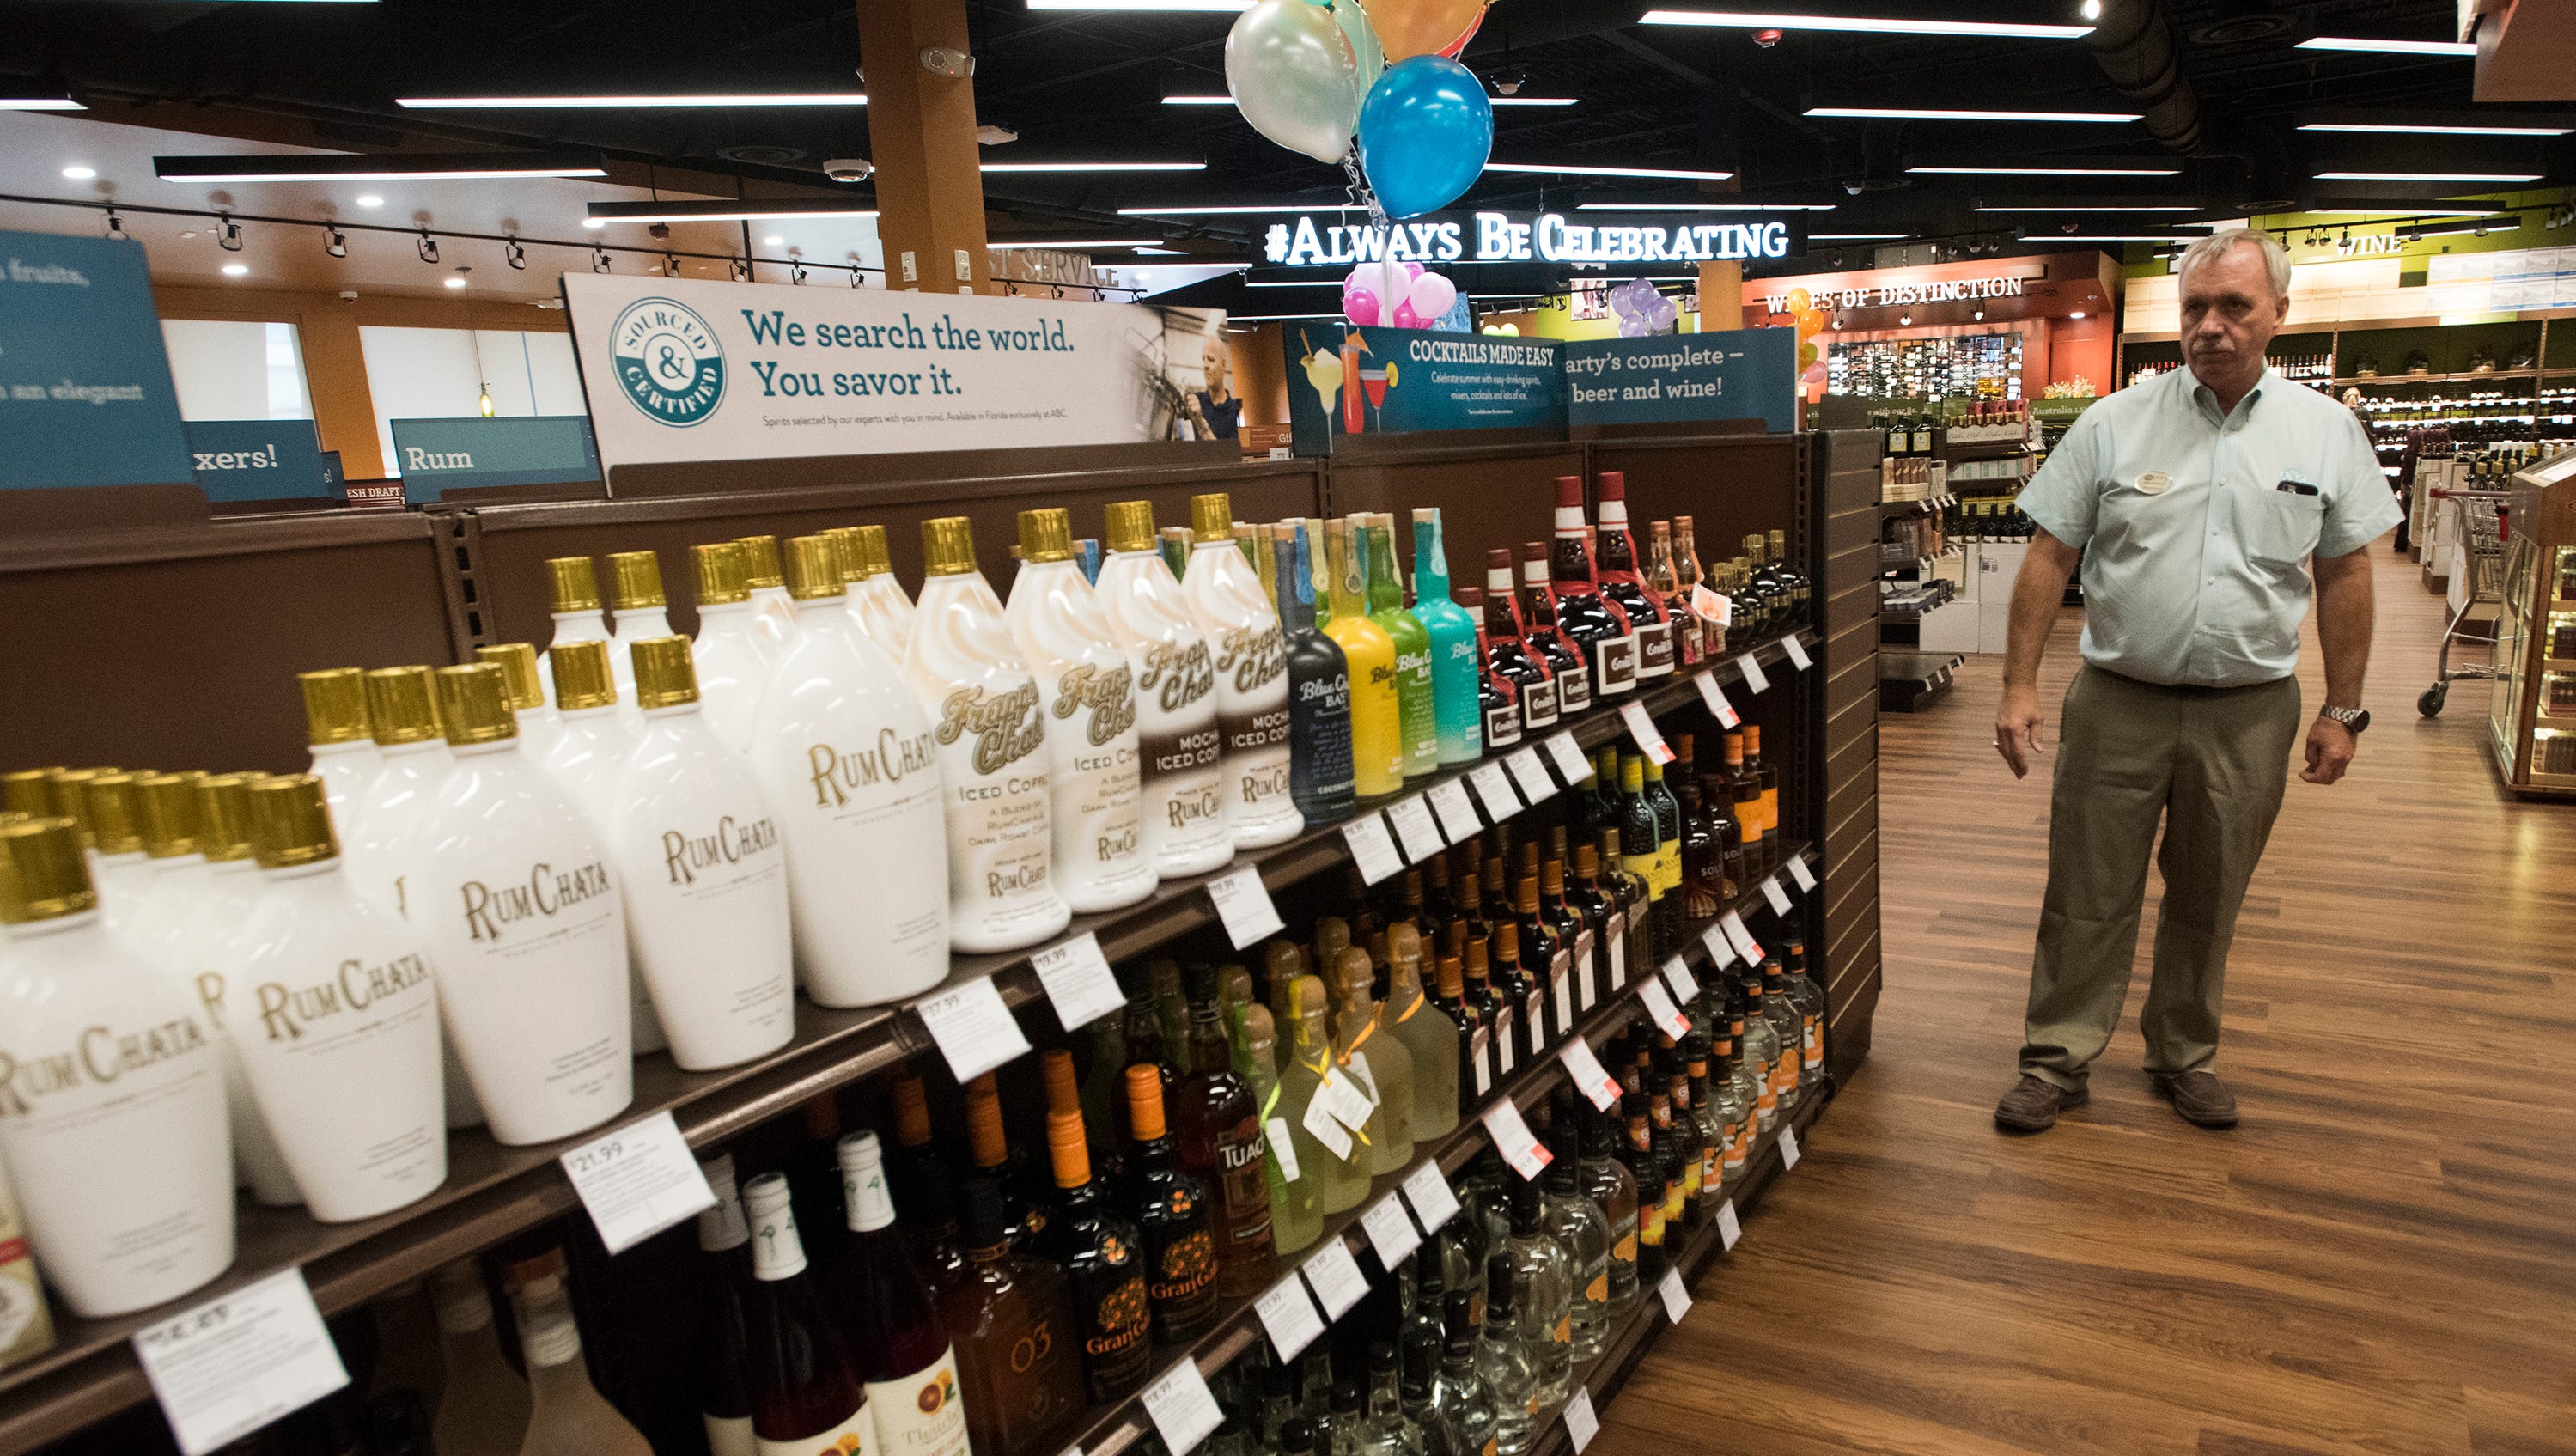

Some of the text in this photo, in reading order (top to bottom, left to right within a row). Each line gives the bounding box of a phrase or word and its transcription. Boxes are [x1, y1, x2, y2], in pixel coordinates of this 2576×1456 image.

[1477, 213, 1531, 259] BE
[1540, 214, 1789, 262] CELEBRATING
[2335, 234, 2402, 257] WINE
[1842, 287, 1870, 308] OF
[1879, 276, 2024, 306] DISTINCTION
[624, 310, 707, 350] SOURCED
[741, 309, 1075, 352] We search the world.
[1410, 339, 1555, 367] COCKTAILS MADE EASY
[1626, 345, 1724, 372] complete
[49, 377, 145, 406] elegant
[626, 366, 717, 415] CERTIFIED
[750, 361, 963, 397] You savor it.
[1572, 376, 1723, 403] beer and wine!
[763, 415, 790, 429] Spirits
[792, 414, 826, 426] selected
[827, 414, 838, 428] by
[839, 416, 853, 425] our
[855, 415, 884, 426] experts
[884, 414, 900, 423] with
[901, 415, 916, 426] you
[2032, 405, 2073, 415] Australia
[192, 443, 278, 471] xers!
[405, 446, 474, 471] Rum
[368, 486, 400, 498] DRAFT
[1231, 731, 1267, 747] ICED
[1074, 756, 1112, 772] ICED
[1156, 752, 1195, 771] ICED
[959, 785, 1002, 801] ICED
